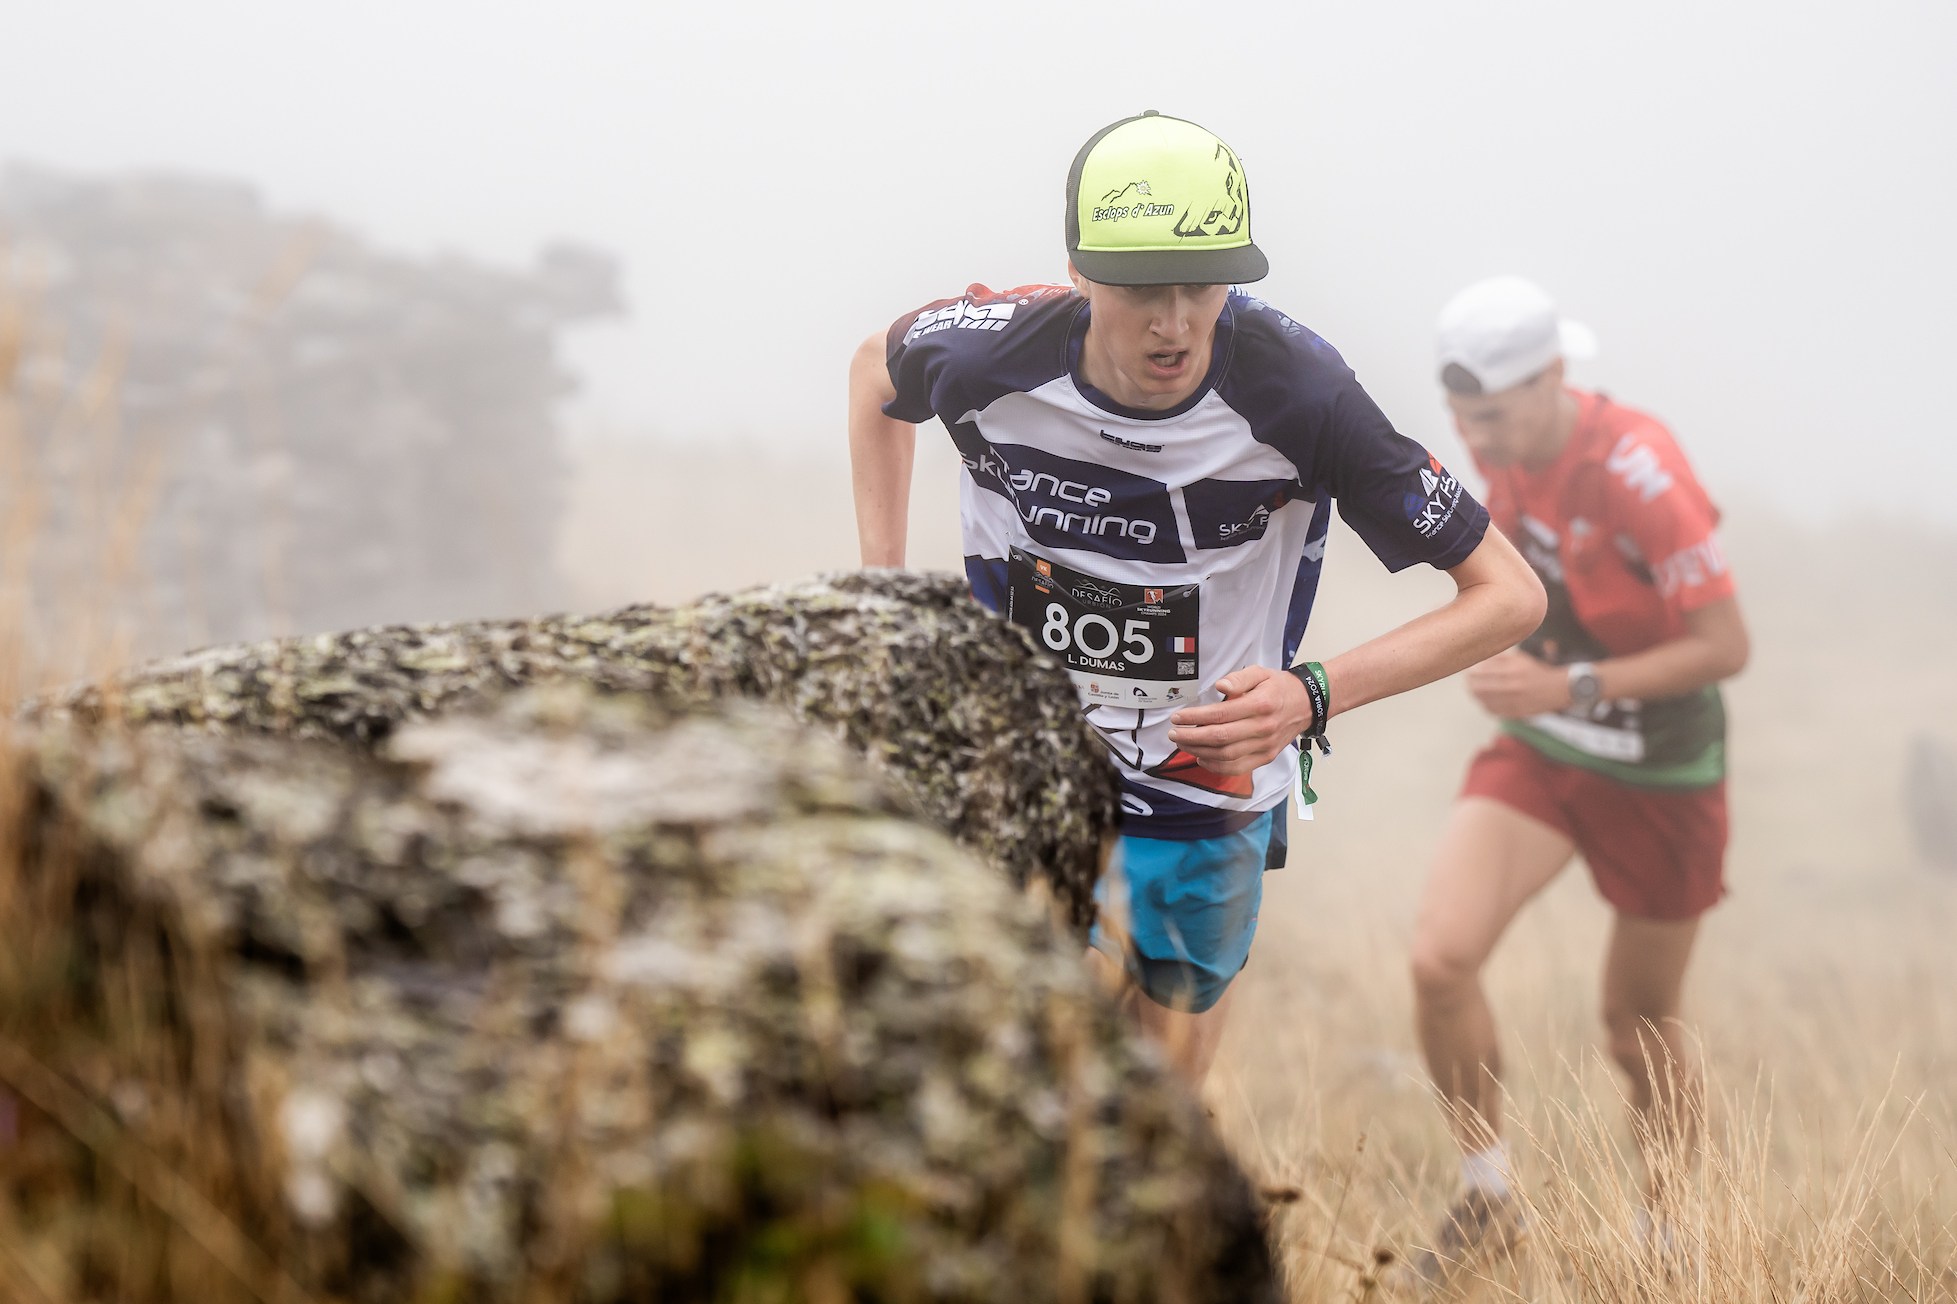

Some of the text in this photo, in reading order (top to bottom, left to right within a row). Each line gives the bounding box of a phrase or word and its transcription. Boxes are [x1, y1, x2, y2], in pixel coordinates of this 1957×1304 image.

[1092, 205, 1129, 222] Esclops
[1143, 203, 1175, 216] Azun
[921, 320, 952, 336] WEAR
[1413, 491, 1446, 535] SKY
[1042, 602, 1155, 664] 805
[1067, 653, 1126, 672] L. DUMAS
